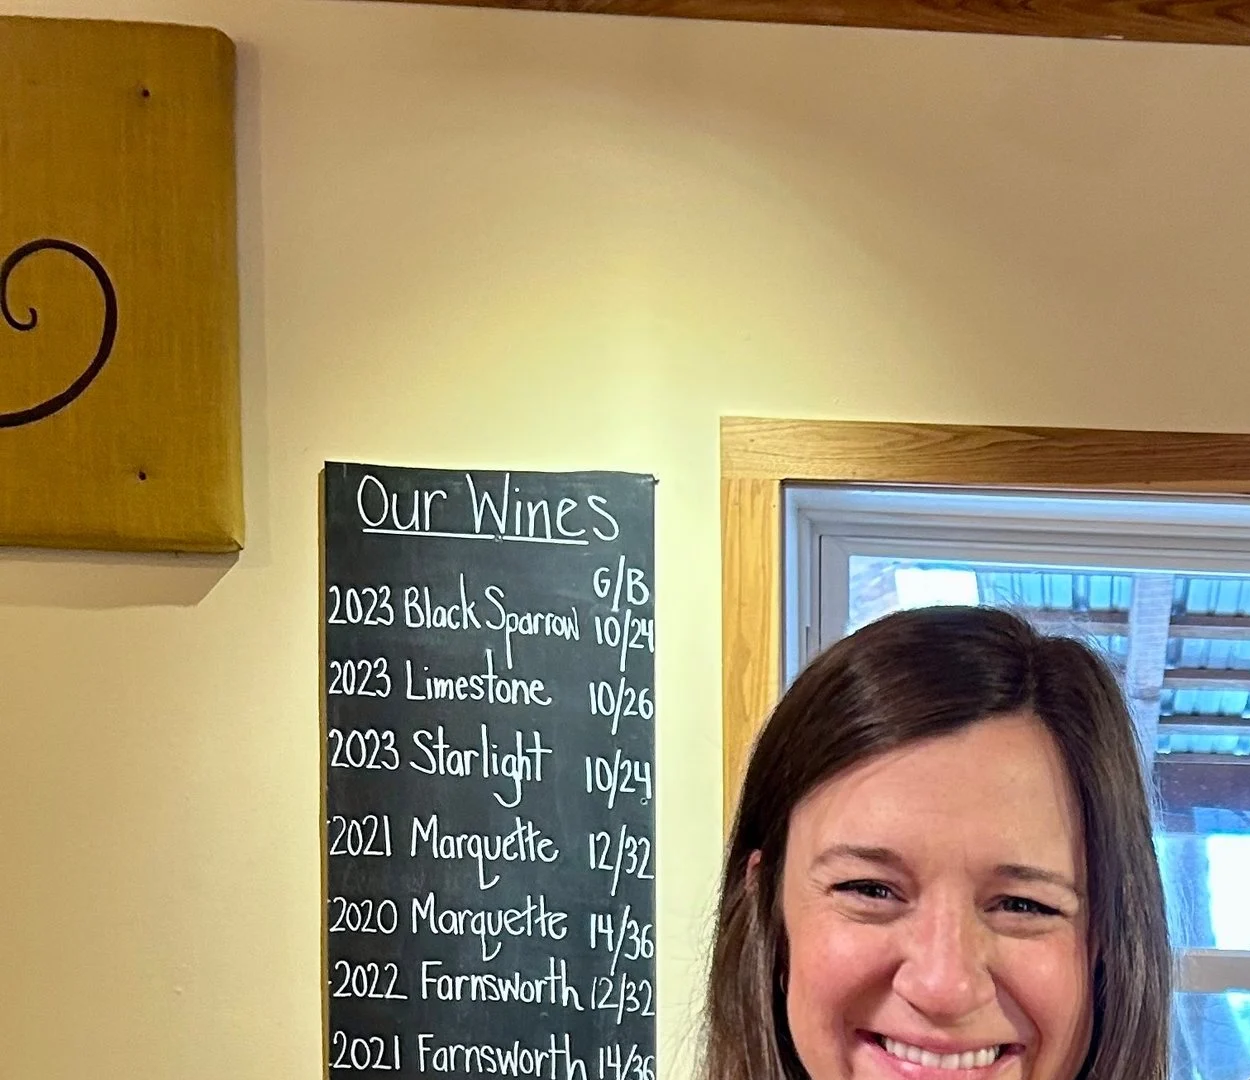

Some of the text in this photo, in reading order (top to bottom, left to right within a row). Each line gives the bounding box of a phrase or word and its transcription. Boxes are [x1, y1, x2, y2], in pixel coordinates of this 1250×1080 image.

[357, 472, 619, 542] Our Wines
[328, 573, 656, 673] 2023 Black Sparrow 10/24
[593, 555, 650, 612] G/B
[329, 649, 655, 735] 2023 Limestone 10/26
[329, 724, 653, 810] 2023 Starlight 10/24
[330, 814, 655, 897] 2021 Marquette 12/32
[330, 892, 654, 976] 2020 Marquette 14/36
[333, 957, 655, 1025] 2022 Farnsworth 12/32
[333, 1031, 400, 1071] 2021
